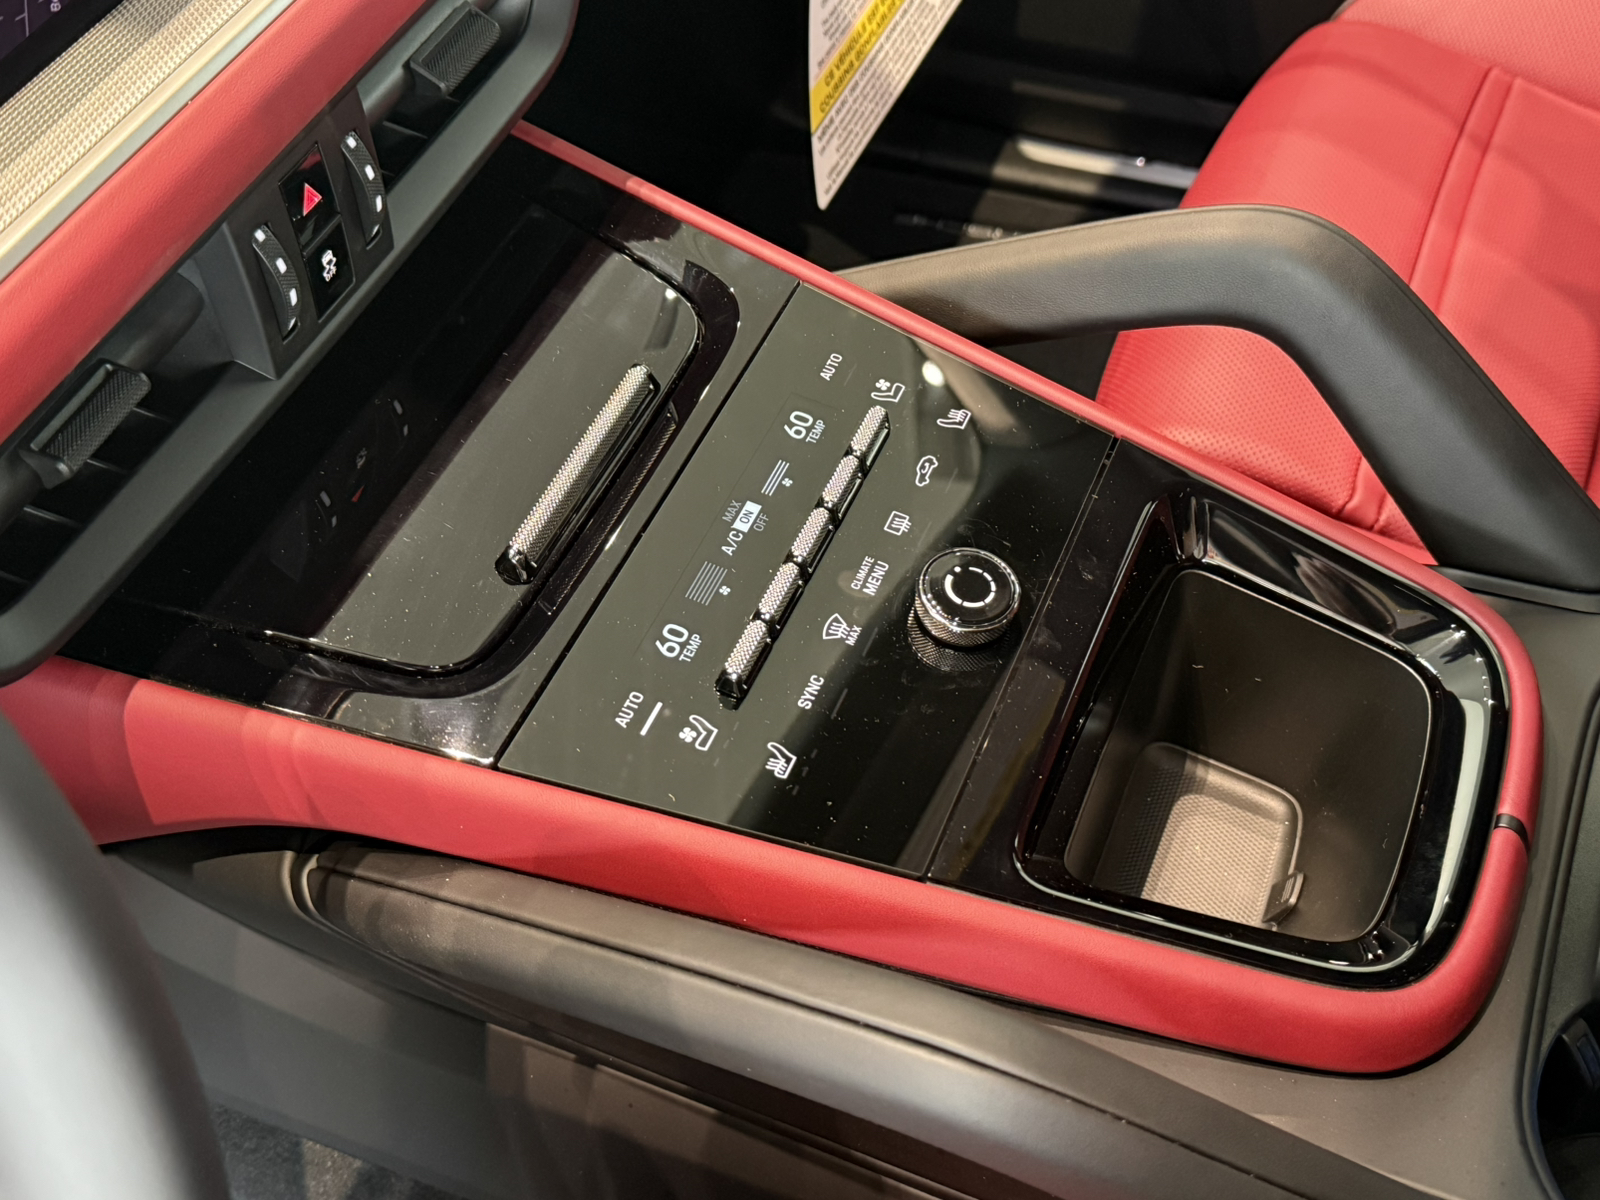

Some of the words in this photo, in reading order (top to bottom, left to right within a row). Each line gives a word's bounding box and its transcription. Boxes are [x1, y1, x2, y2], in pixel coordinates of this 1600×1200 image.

[820, 353, 843, 381] AUTO
[783, 410, 814, 440] 60
[805, 419, 826, 444] TEMP
[721, 500, 742, 523] MAX
[753, 513, 769, 532] OFF
[721, 530, 744, 556] A/C
[739, 510, 755, 524] ON
[850, 555, 875, 590] CLIMATE
[862, 560, 890, 596] MENU
[655, 623, 689, 658] 60
[679, 633, 702, 663] TEMP
[845, 624, 862, 646] MAX
[797, 674, 825, 710] SYNC
[614, 691, 644, 729] AUTO
